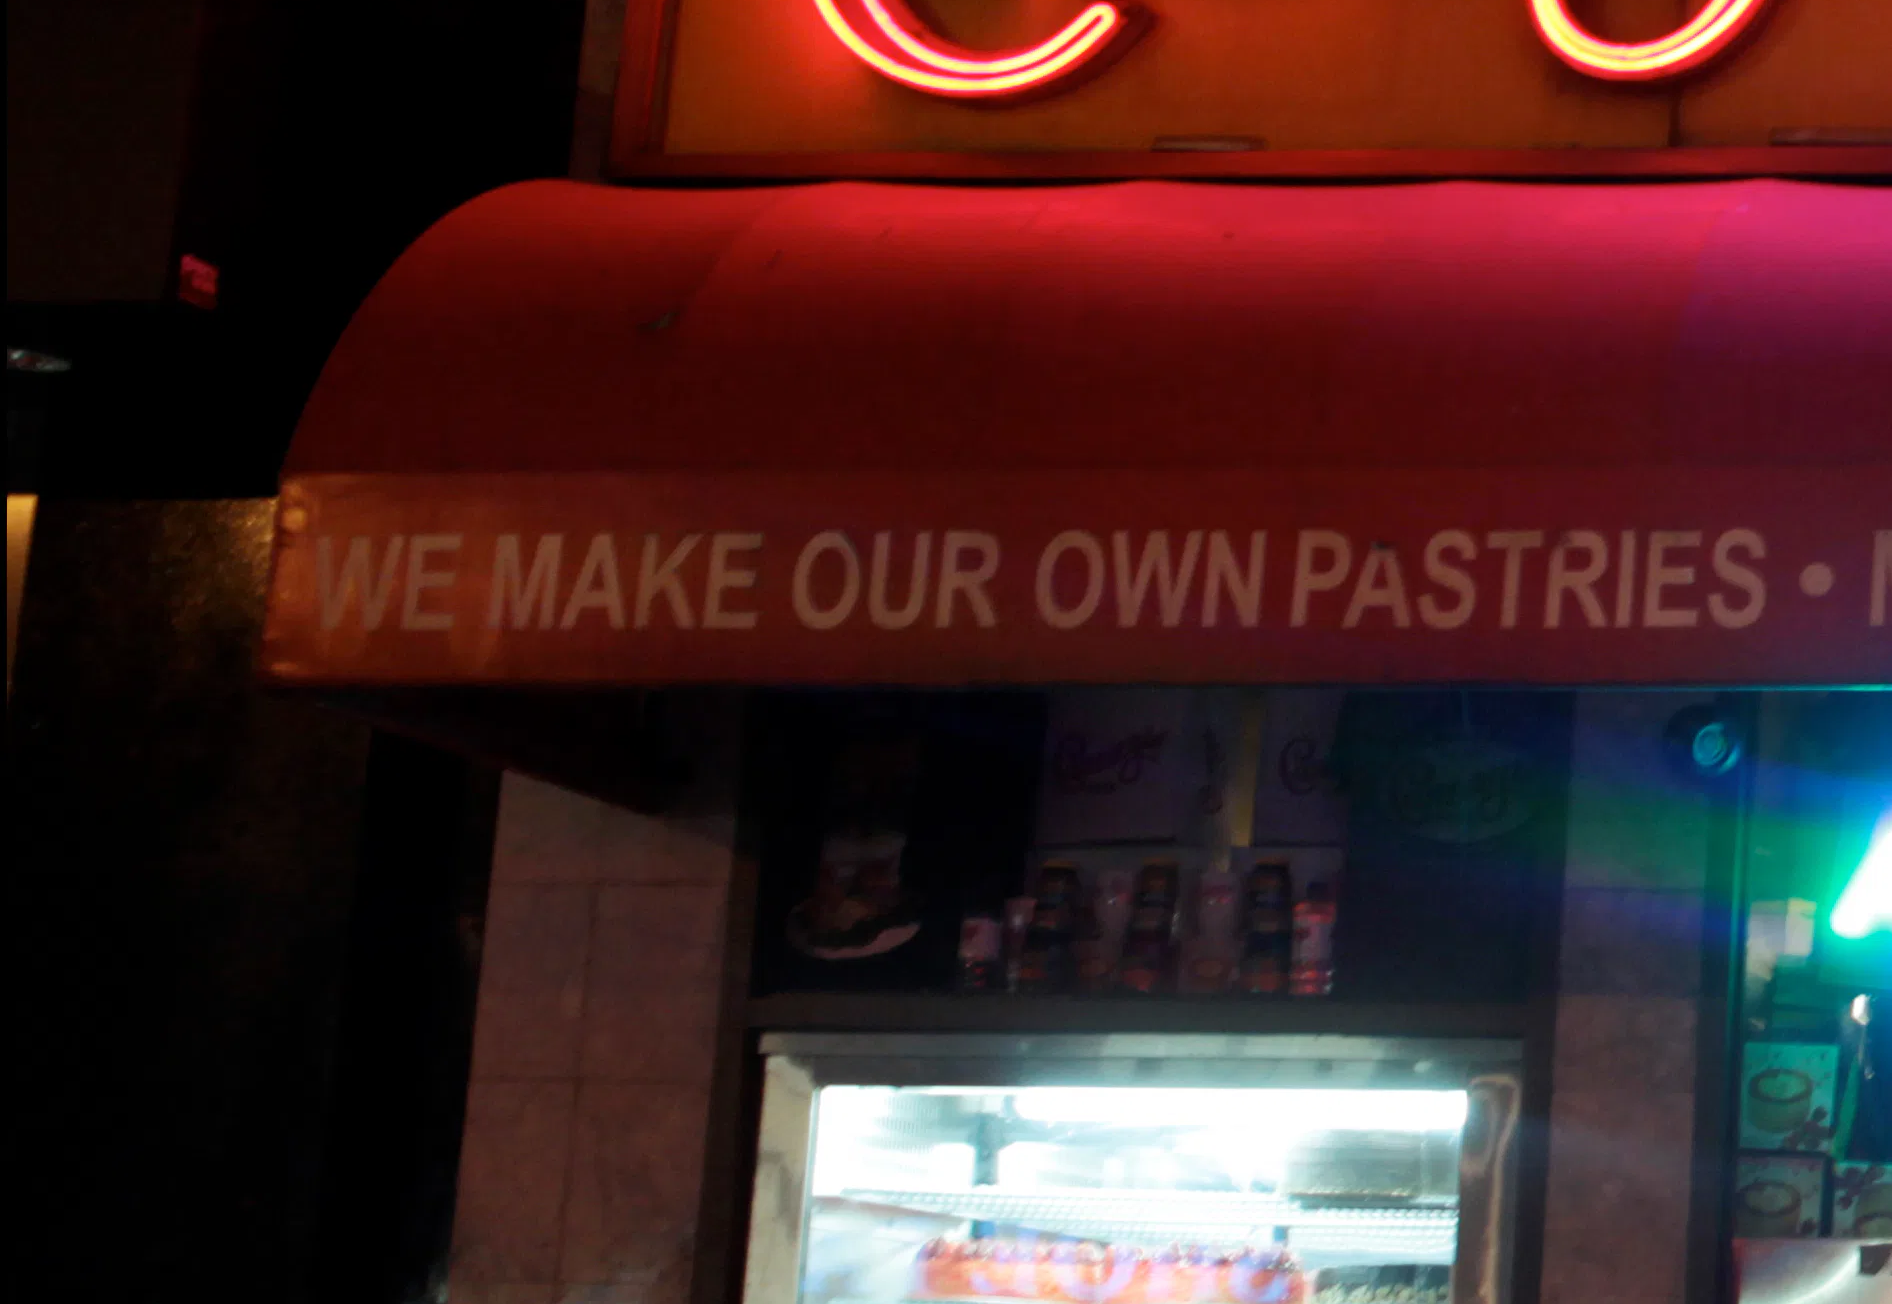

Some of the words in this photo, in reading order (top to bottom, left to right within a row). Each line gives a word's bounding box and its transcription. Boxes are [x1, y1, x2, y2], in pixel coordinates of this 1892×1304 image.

[315, 531, 461, 633] WE
[488, 531, 764, 633] MAKE
[791, 529, 1001, 632] OUR
[1032, 529, 1266, 632] OWN
[1288, 528, 1768, 632] PASTRIES
